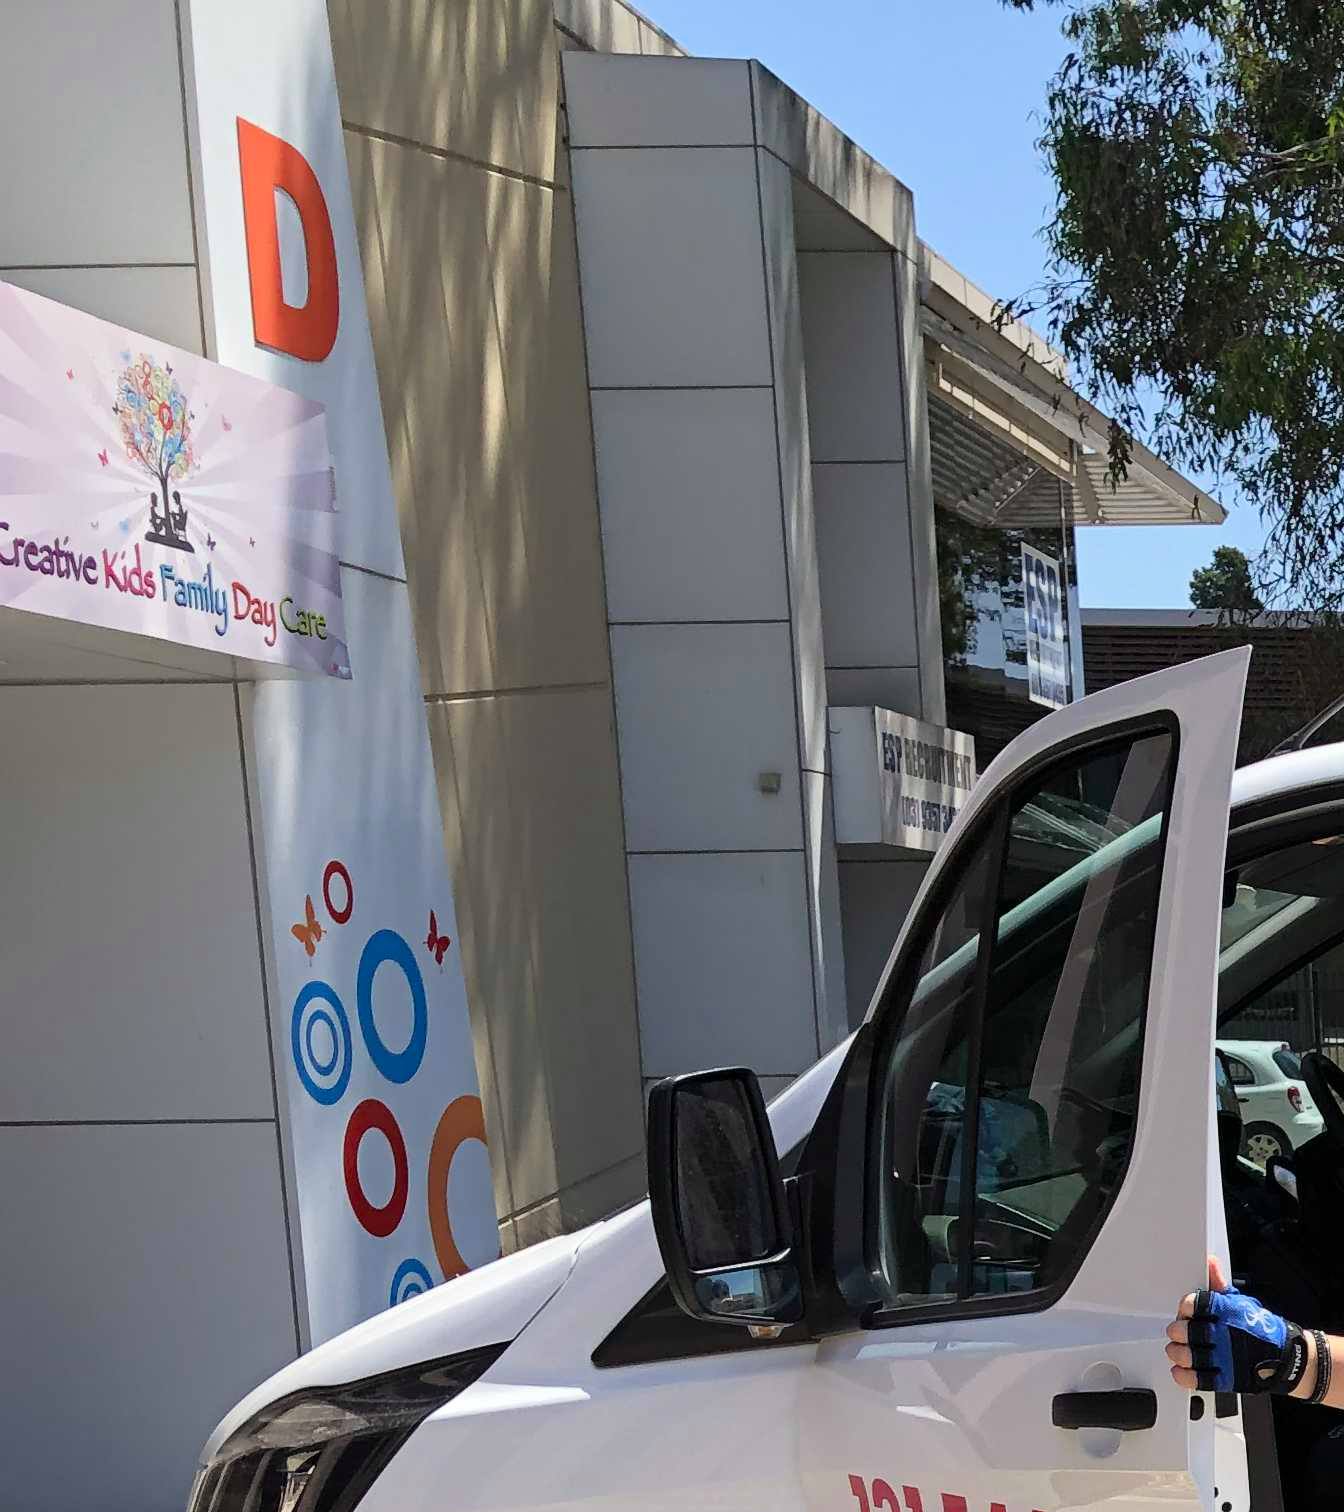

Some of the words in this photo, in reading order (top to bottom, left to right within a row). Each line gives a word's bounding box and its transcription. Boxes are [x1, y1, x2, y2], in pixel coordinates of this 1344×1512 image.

[236, 116, 339, 363] D
[102, 543, 156, 599] Kids
[160, 562, 228, 636] Family
[232, 581, 277, 647] Day
[279, 597, 327, 640] Care
[881, 731, 902, 774] ESP
